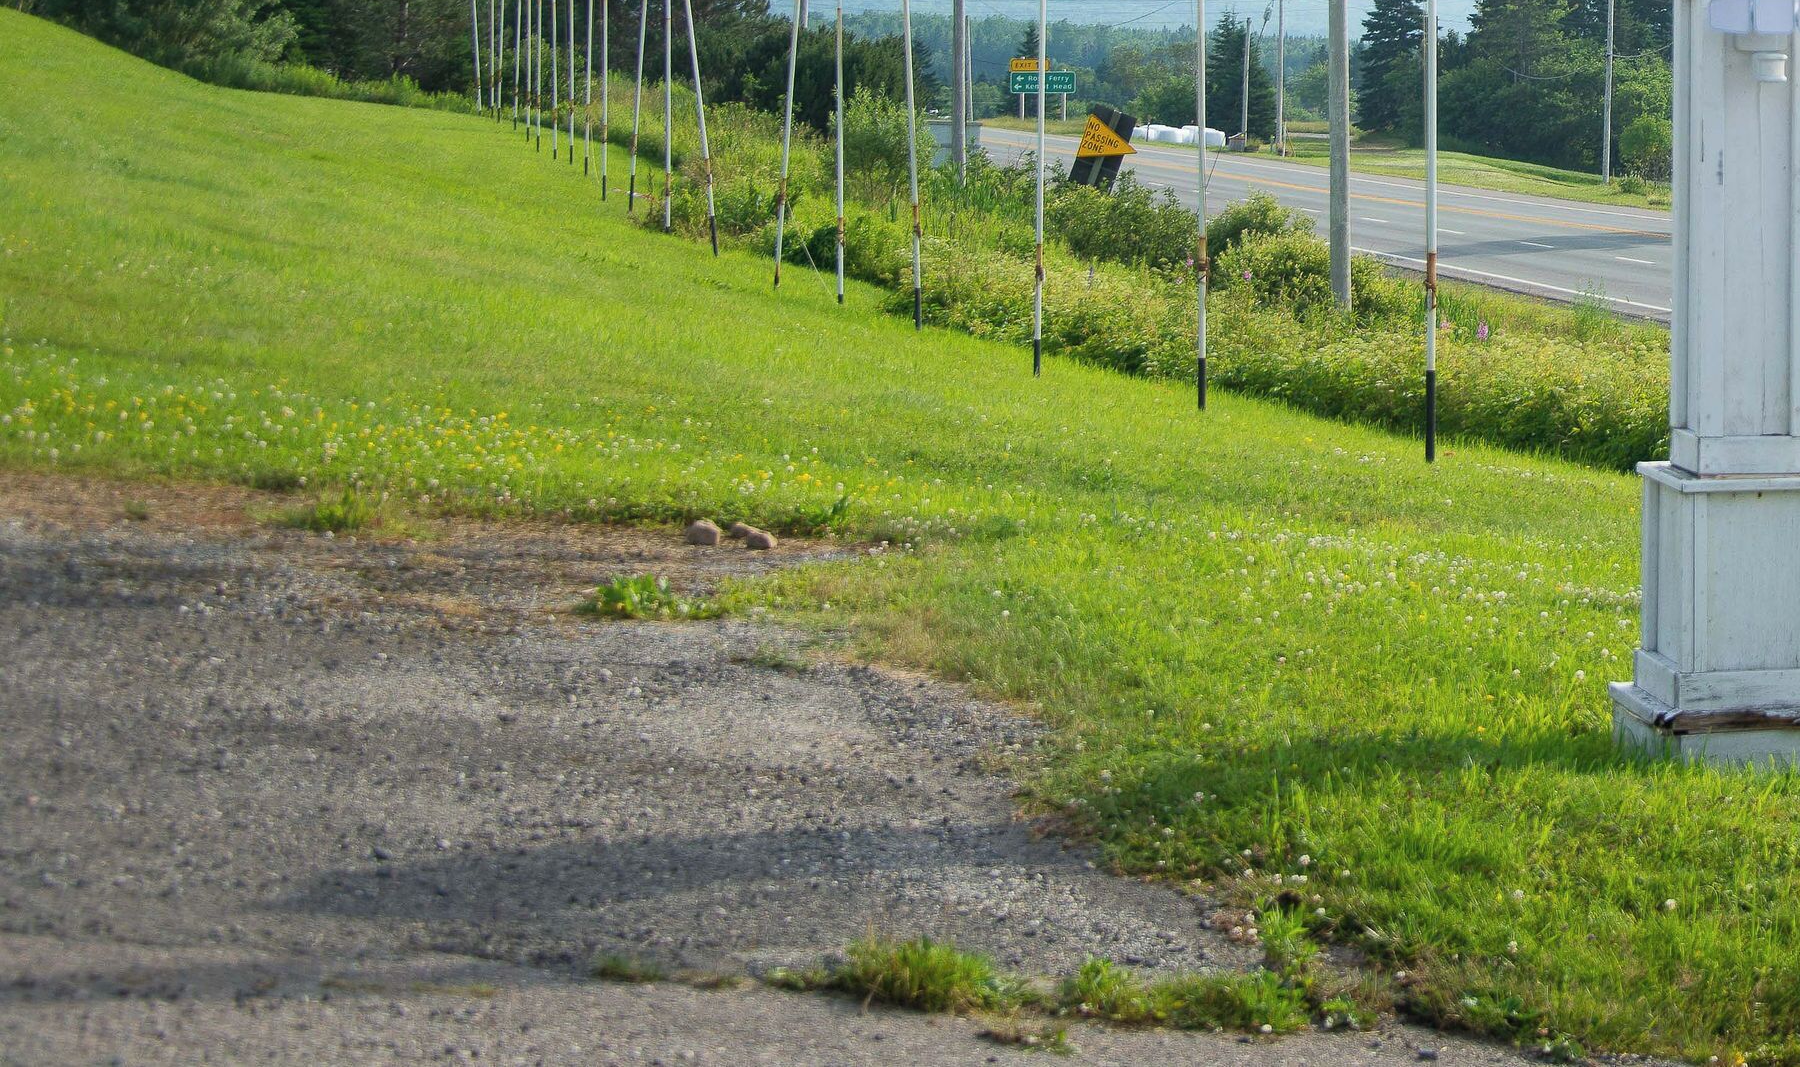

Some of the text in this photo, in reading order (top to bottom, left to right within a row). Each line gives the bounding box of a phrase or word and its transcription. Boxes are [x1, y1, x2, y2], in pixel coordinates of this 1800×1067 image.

[1015, 62, 1032, 70] EXIT
[1048, 75, 1070, 83] Ferry
[1088, 121, 1101, 132] NO
[1085, 130, 1120, 149] PASSING
[1081, 139, 1105, 154] ZONE
